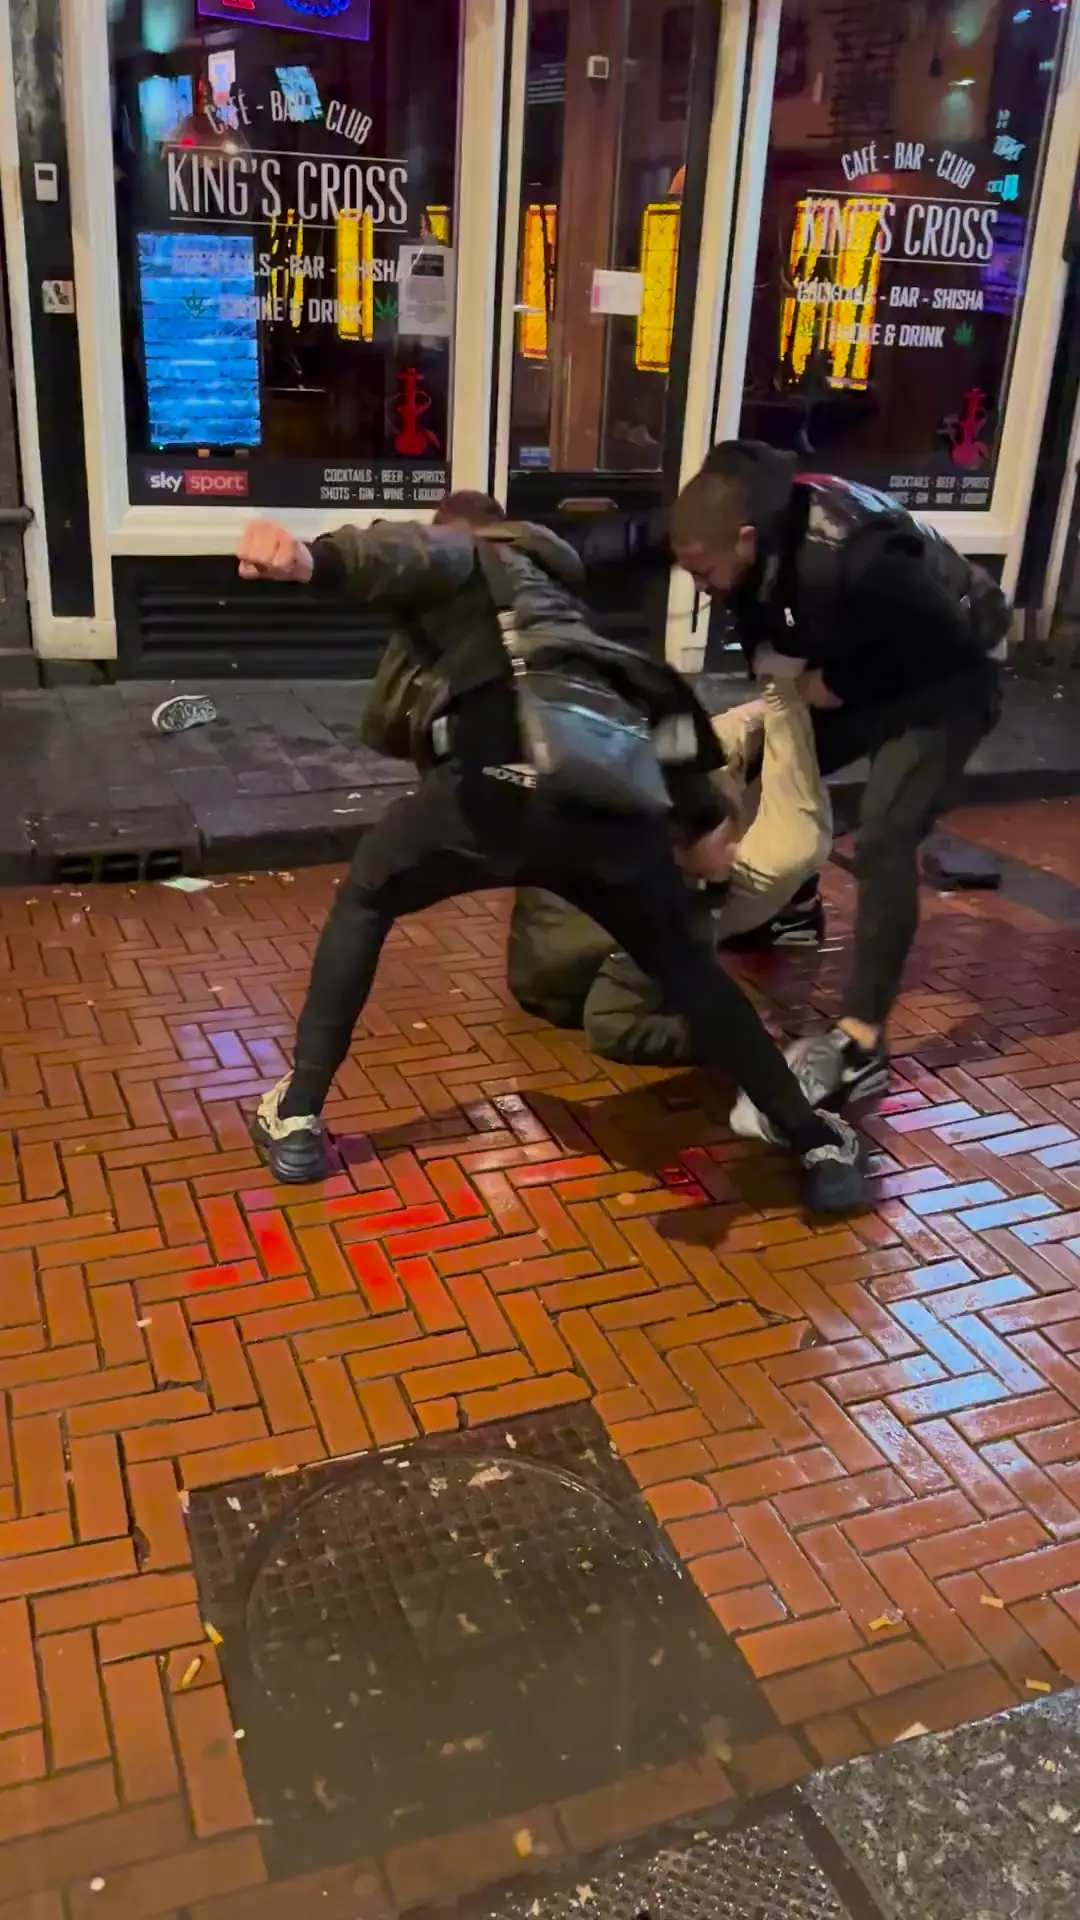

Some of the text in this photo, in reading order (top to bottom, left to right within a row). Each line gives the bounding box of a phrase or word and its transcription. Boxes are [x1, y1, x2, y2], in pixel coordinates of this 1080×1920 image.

[325, 99, 373, 145] CLUB
[841, 141, 880, 181] CAFÉ
[894, 142, 926, 171] BAR
[936, 150, 977, 190] CLUB
[167, 152, 409, 225] KING'S CROSS
[903, 202, 999, 260] CROSS
[289, 254, 325, 280] BAR
[889, 286, 917, 308] BAR
[932, 288, 984, 311] SHISHA
[883, 324, 896, 346] &
[899, 324, 945, 348] DRINK
[150, 471, 246, 493] sky sport
[324, 468, 373, 482] COCKTAILS
[381, 470, 403, 483] BEER
[411, 470, 446, 484] SPIRITS
[320, 486, 350, 500] SHOTS
